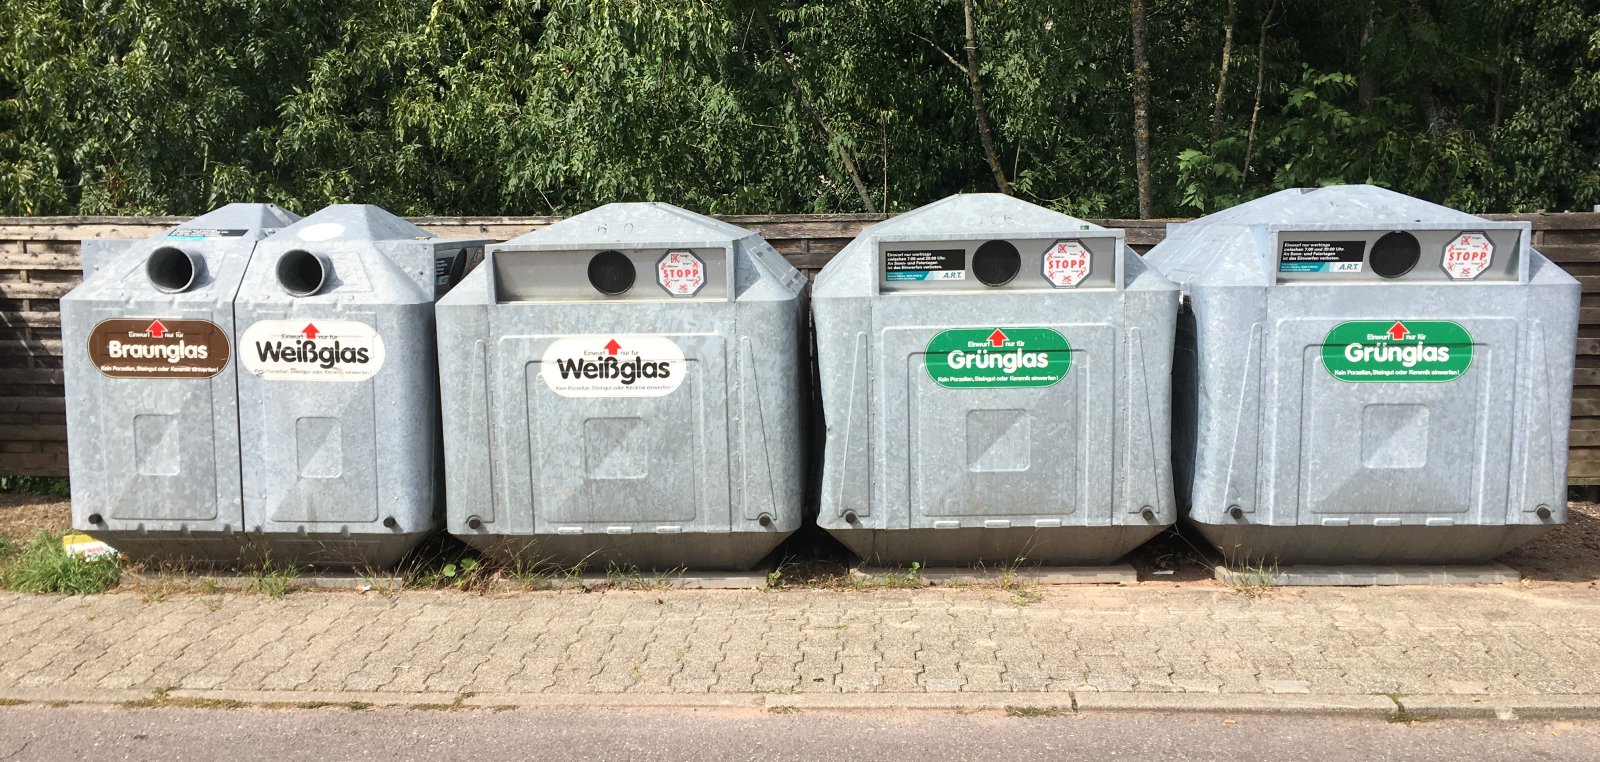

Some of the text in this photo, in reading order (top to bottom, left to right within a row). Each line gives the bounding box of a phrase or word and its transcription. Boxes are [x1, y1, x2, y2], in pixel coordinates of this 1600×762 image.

[1049, 260, 1085, 269] STOPP
[1449, 252, 1486, 261] STOPP
[664, 270, 698, 278] STOPP
[108, 340, 208, 363] Braunglas
[255, 340, 369, 369] Weißglas
[947, 348, 1049, 373] Grünglas
[1344, 342, 1450, 367] Grünglas
[557, 356, 670, 385] Weißglas
